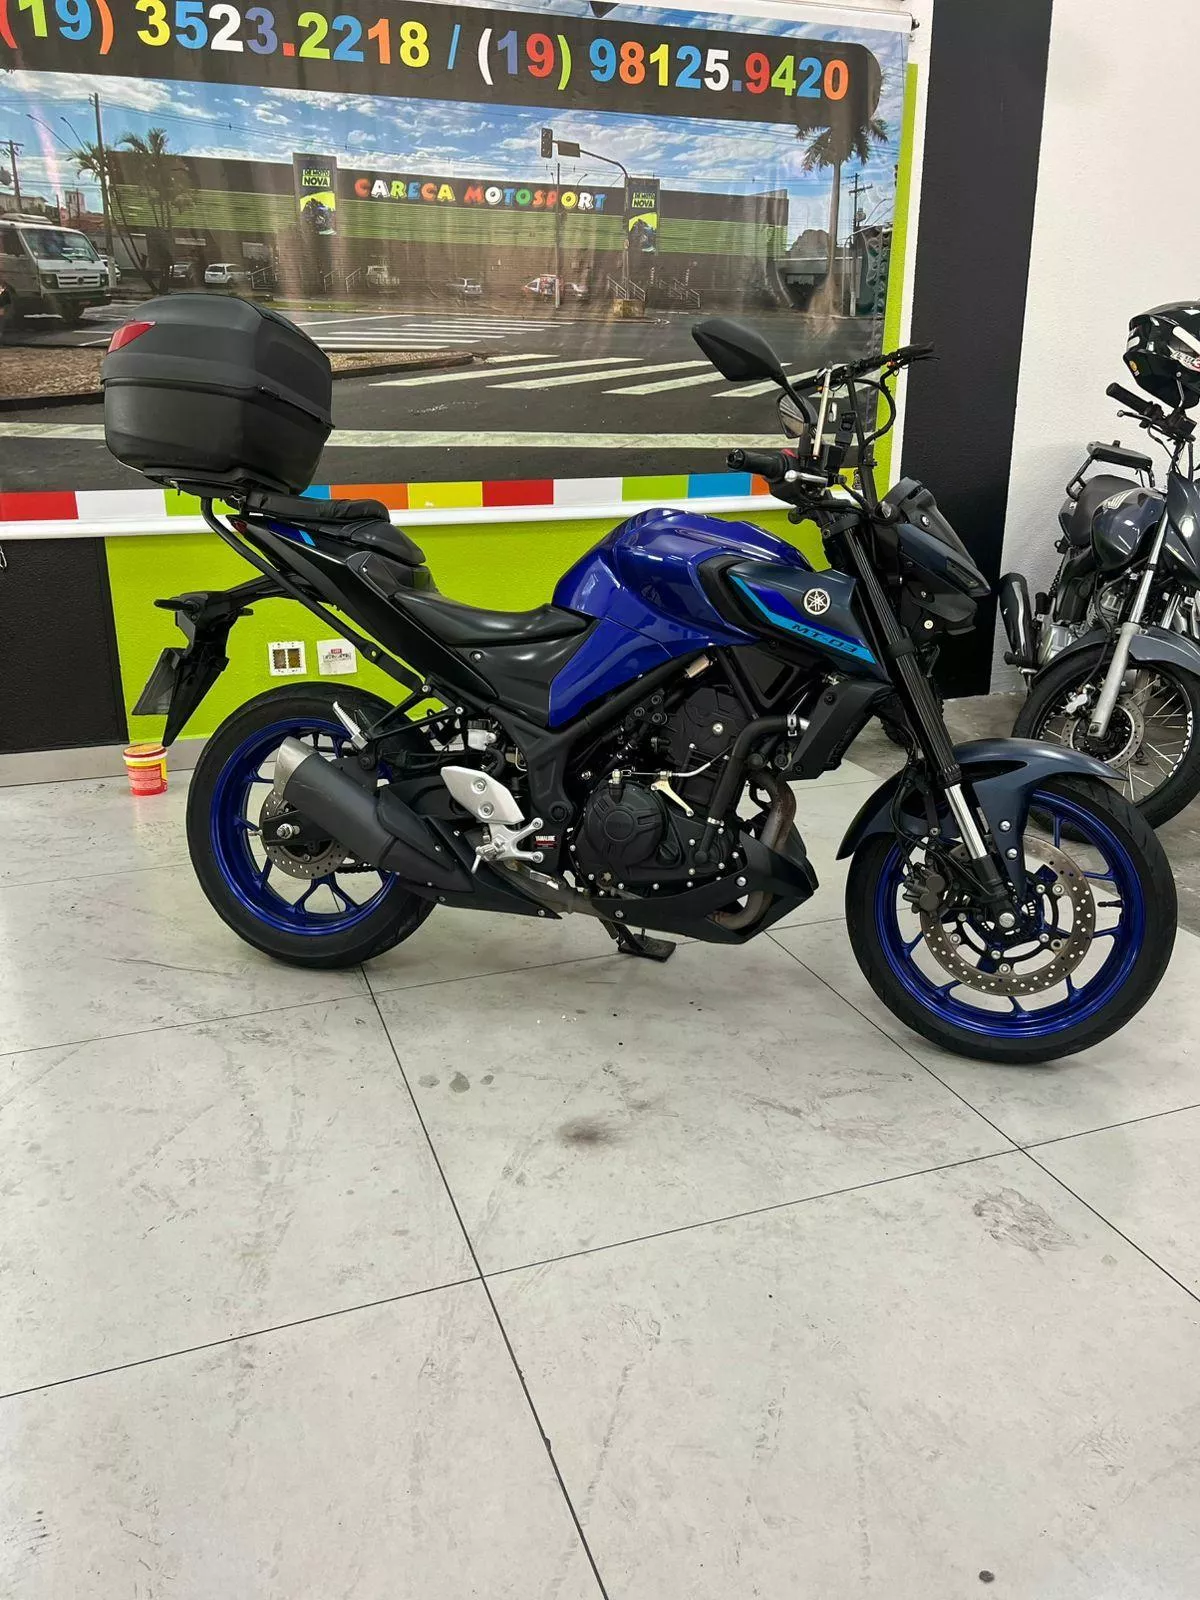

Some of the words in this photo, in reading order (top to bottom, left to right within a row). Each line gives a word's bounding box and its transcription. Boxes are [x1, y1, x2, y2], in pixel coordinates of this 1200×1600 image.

[0, 0, 114, 55] (19)
[136, 0, 431, 68] 3523.2218
[478, 28, 572, 90] (19)
[589, 38, 849, 100] 98125.9420
[304, 176, 329, 186] NOVA
[354, 178, 456, 202] CARECA
[463, 184, 606, 211] MOTOSPORT
[633, 199, 653, 207] NOVA
[792, 623, 858, 653] MT-03
